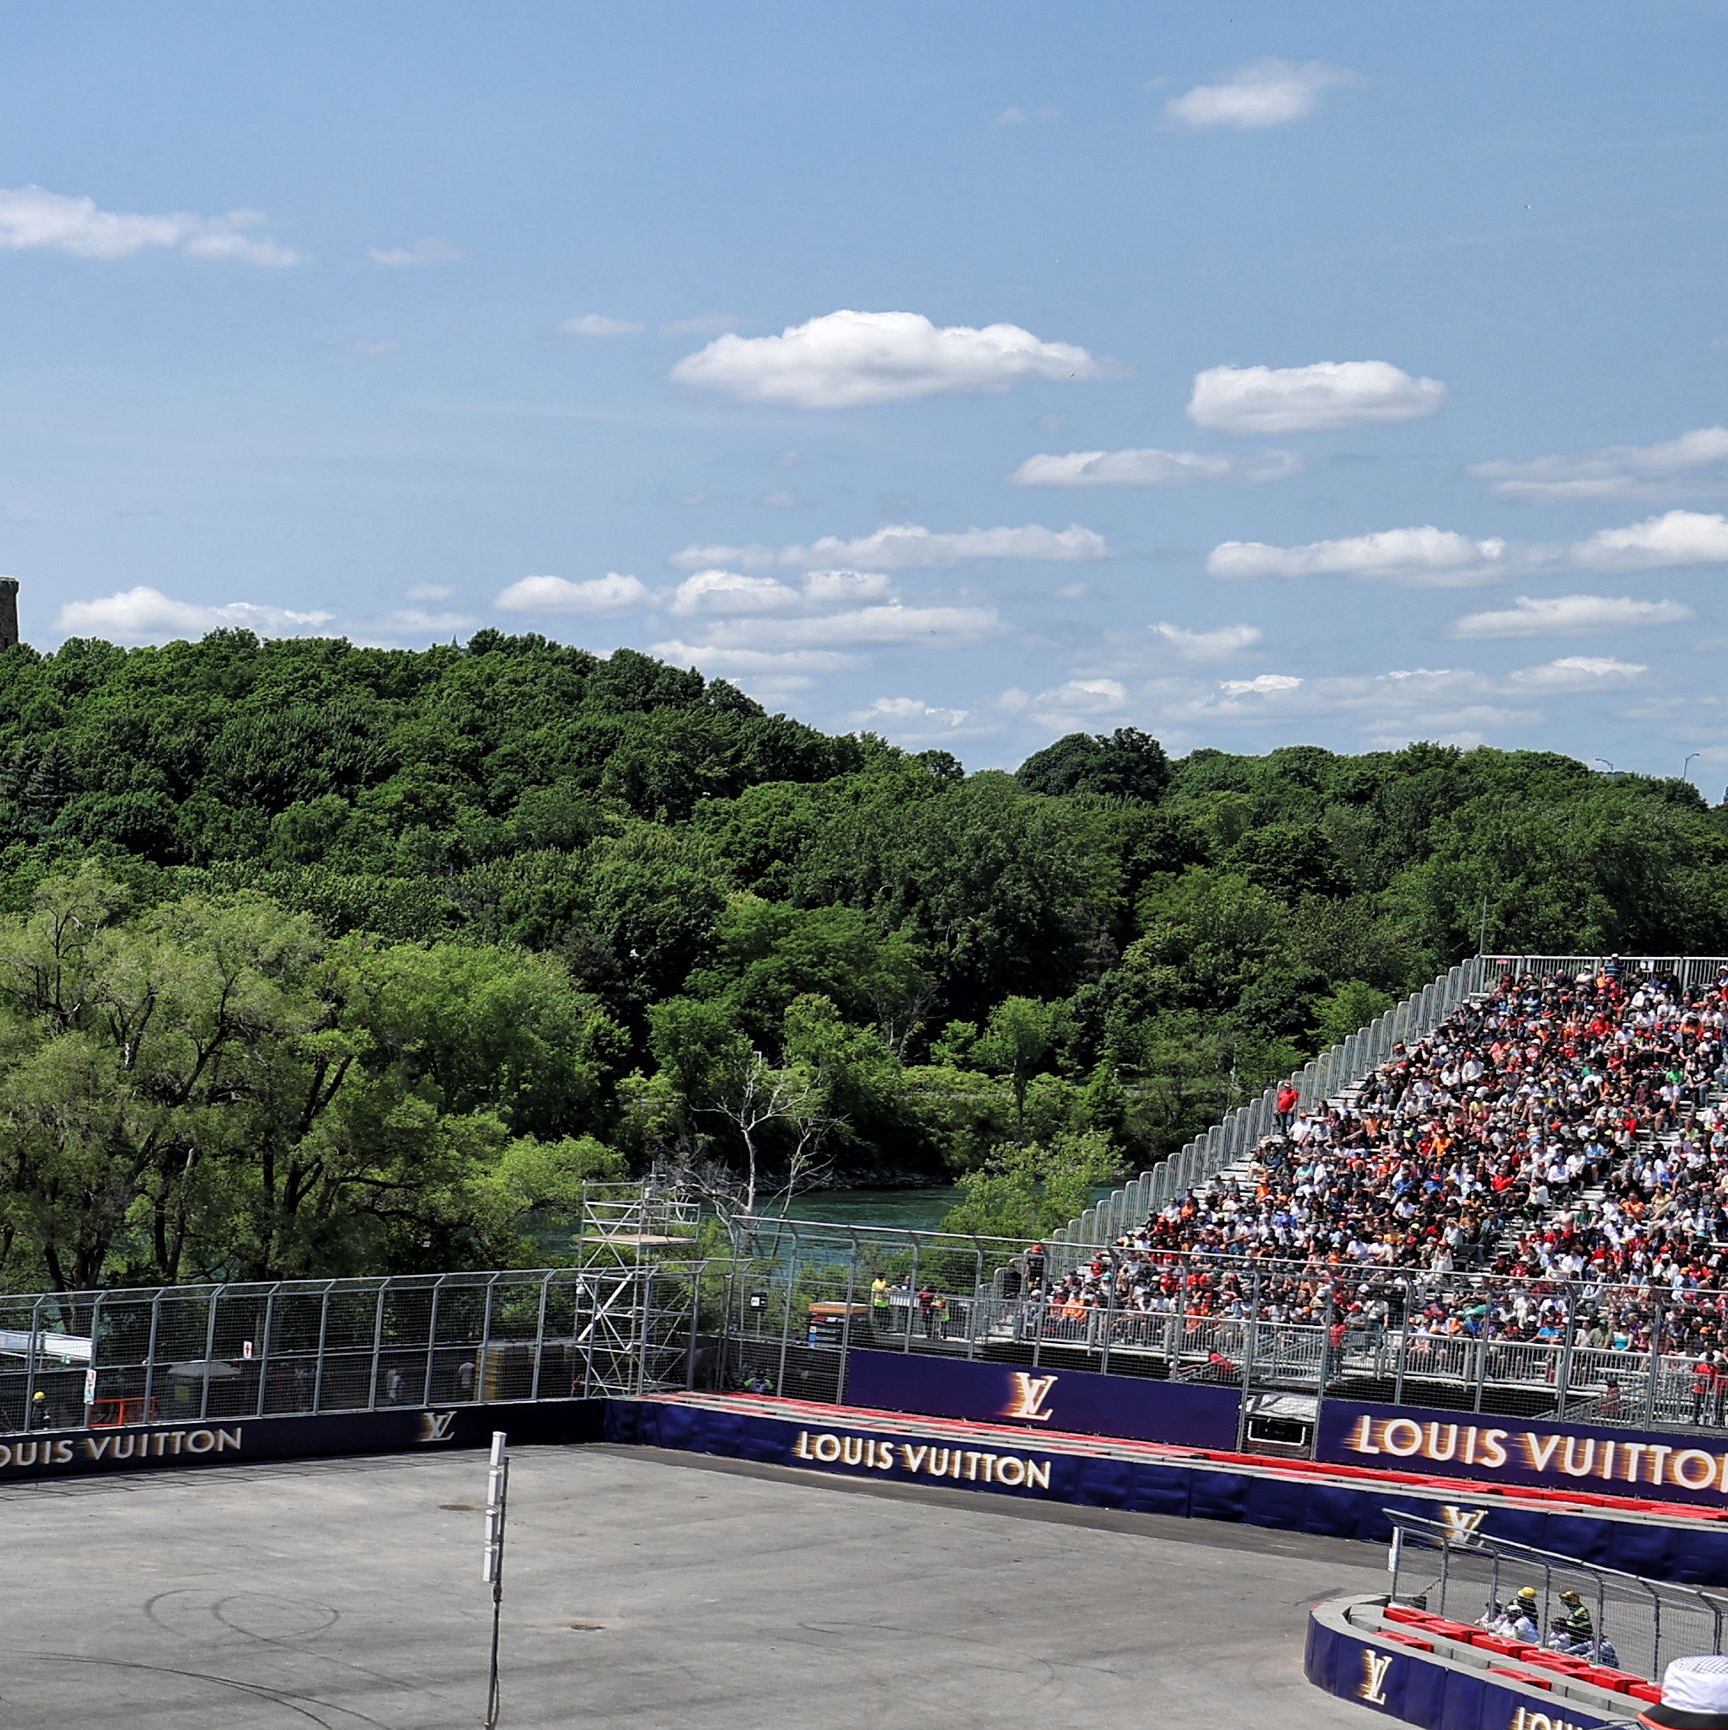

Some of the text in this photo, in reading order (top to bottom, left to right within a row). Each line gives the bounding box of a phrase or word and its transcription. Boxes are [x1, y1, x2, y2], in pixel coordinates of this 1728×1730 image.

[86, 1426, 244, 1461] VUITTON
[796, 1430, 1052, 1490] LOUIS VUITTON
[1358, 1414, 1509, 1469] LOUIS
